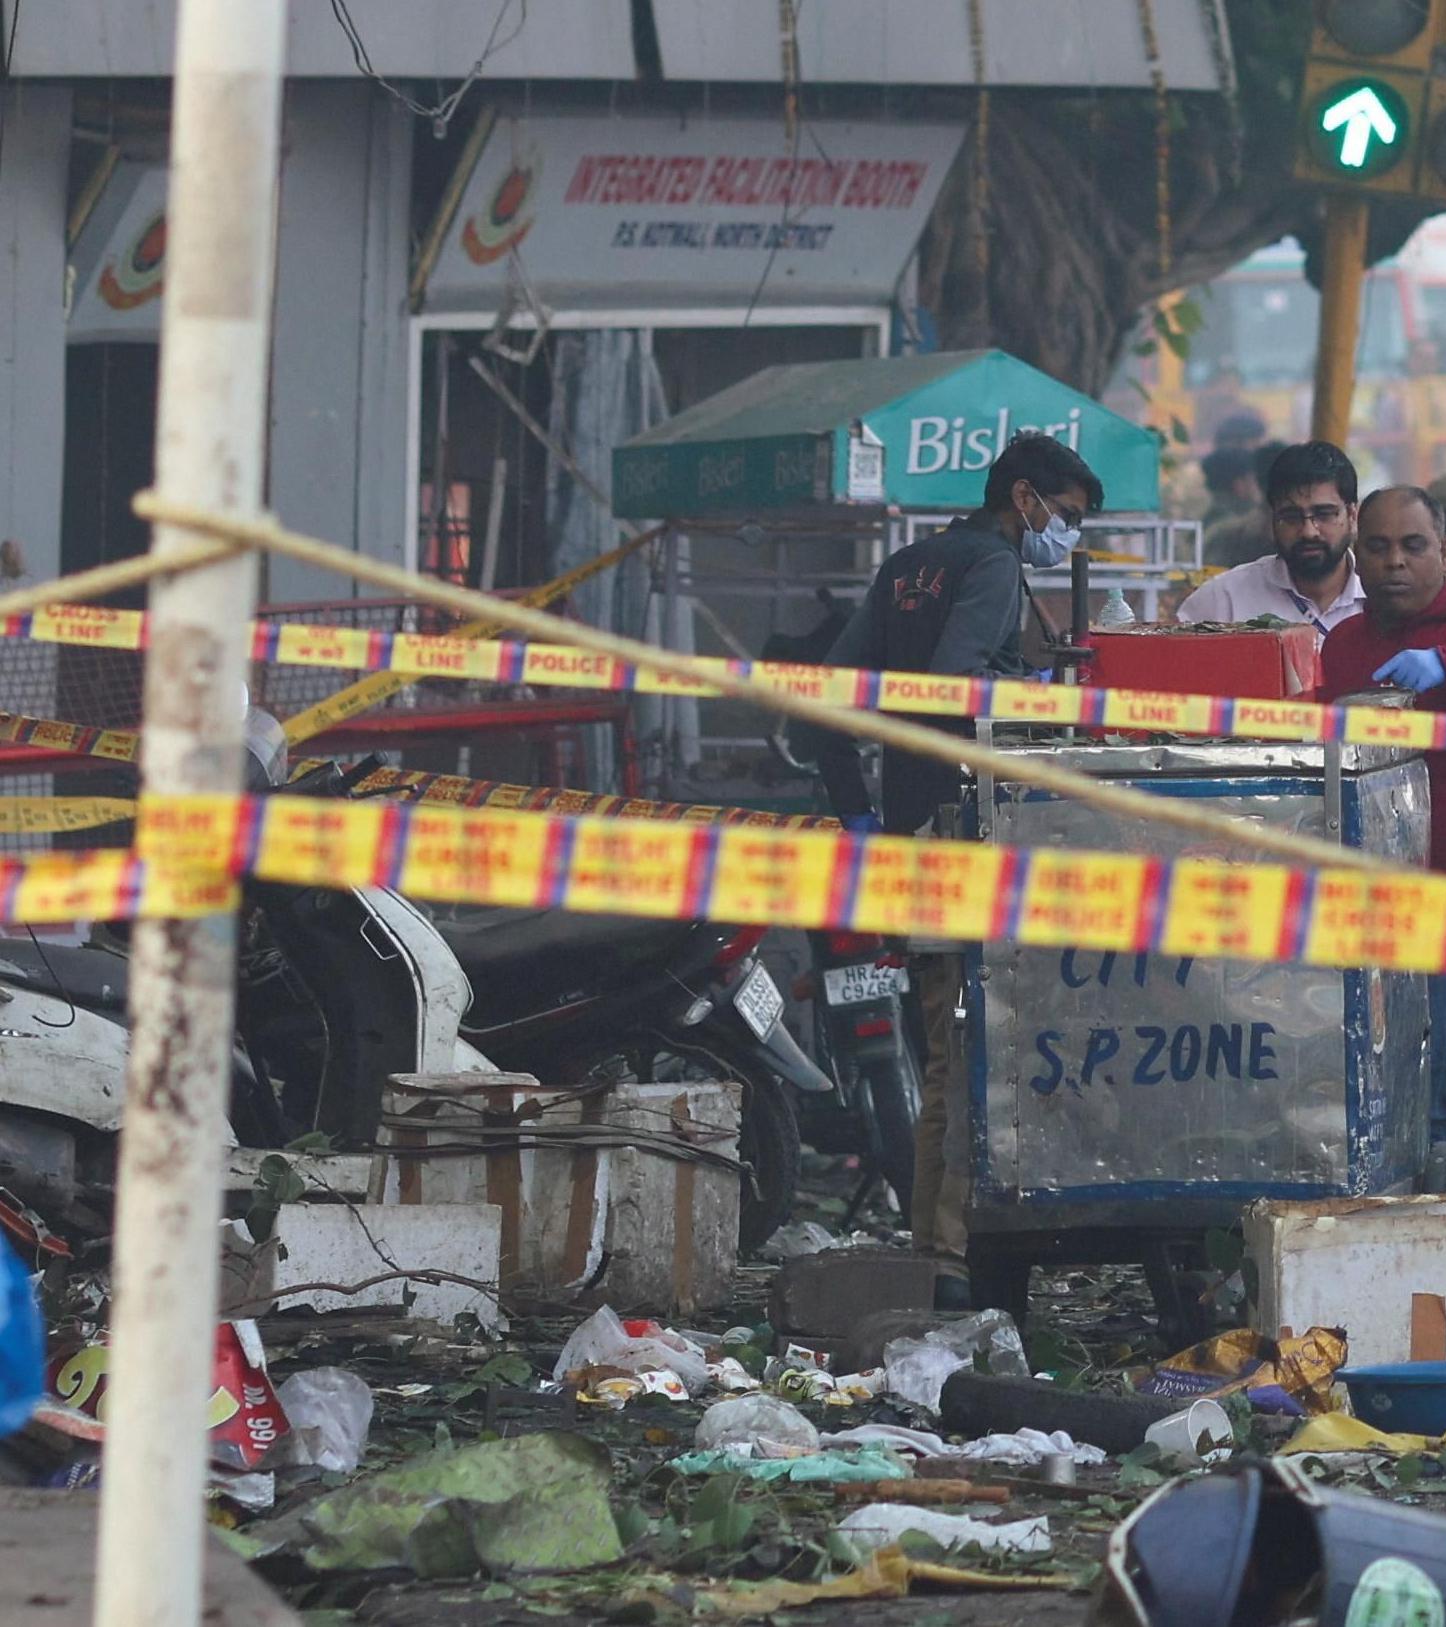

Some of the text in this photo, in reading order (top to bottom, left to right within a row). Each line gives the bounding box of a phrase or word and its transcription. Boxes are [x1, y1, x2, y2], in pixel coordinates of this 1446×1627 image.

[564, 155, 930, 209] INTEGRATED FACILITATION BOOTH
[763, 223, 834, 250] DISTRICT
[416, 651, 466, 671] LINE
[528, 652, 610, 677] POLICE
[885, 679, 964, 703] POLICE
[1128, 704, 1178, 724] LINE
[1238, 706, 1317, 729] POLICE
[1132, 1021, 1280, 1086] ZONE
